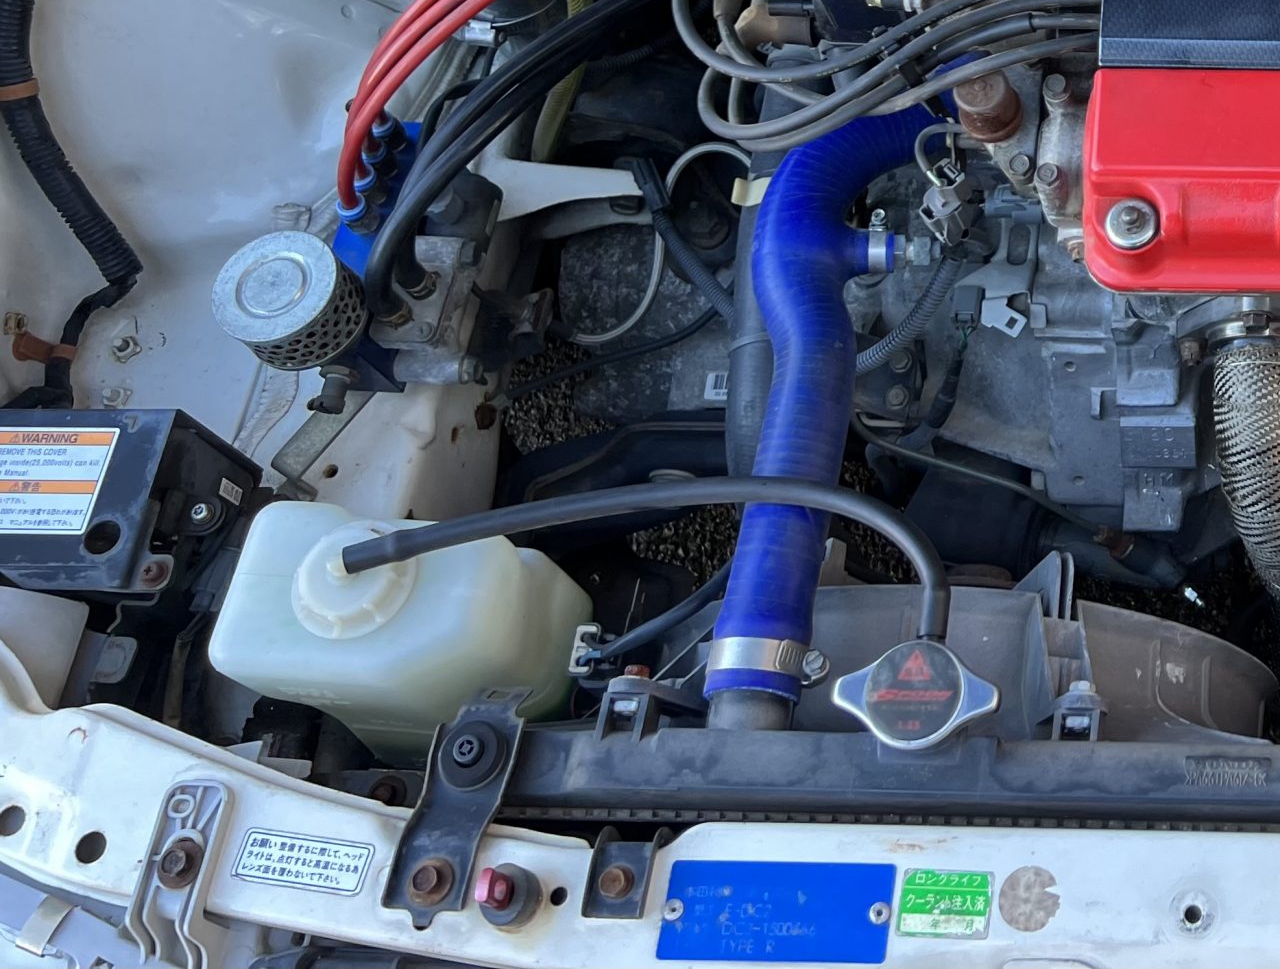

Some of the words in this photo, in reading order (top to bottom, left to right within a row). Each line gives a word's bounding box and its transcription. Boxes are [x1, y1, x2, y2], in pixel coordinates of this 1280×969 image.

[22, 433, 79, 444] WARNING
[27, 448, 42, 456] THIS
[21, 481, 42, 492] 警告
[250, 837, 277, 848] お願い
[915, 873, 982, 887] ロングライフ
[905, 893, 986, 911] クーラント注入済
[720, 939, 755, 954] TYPE
